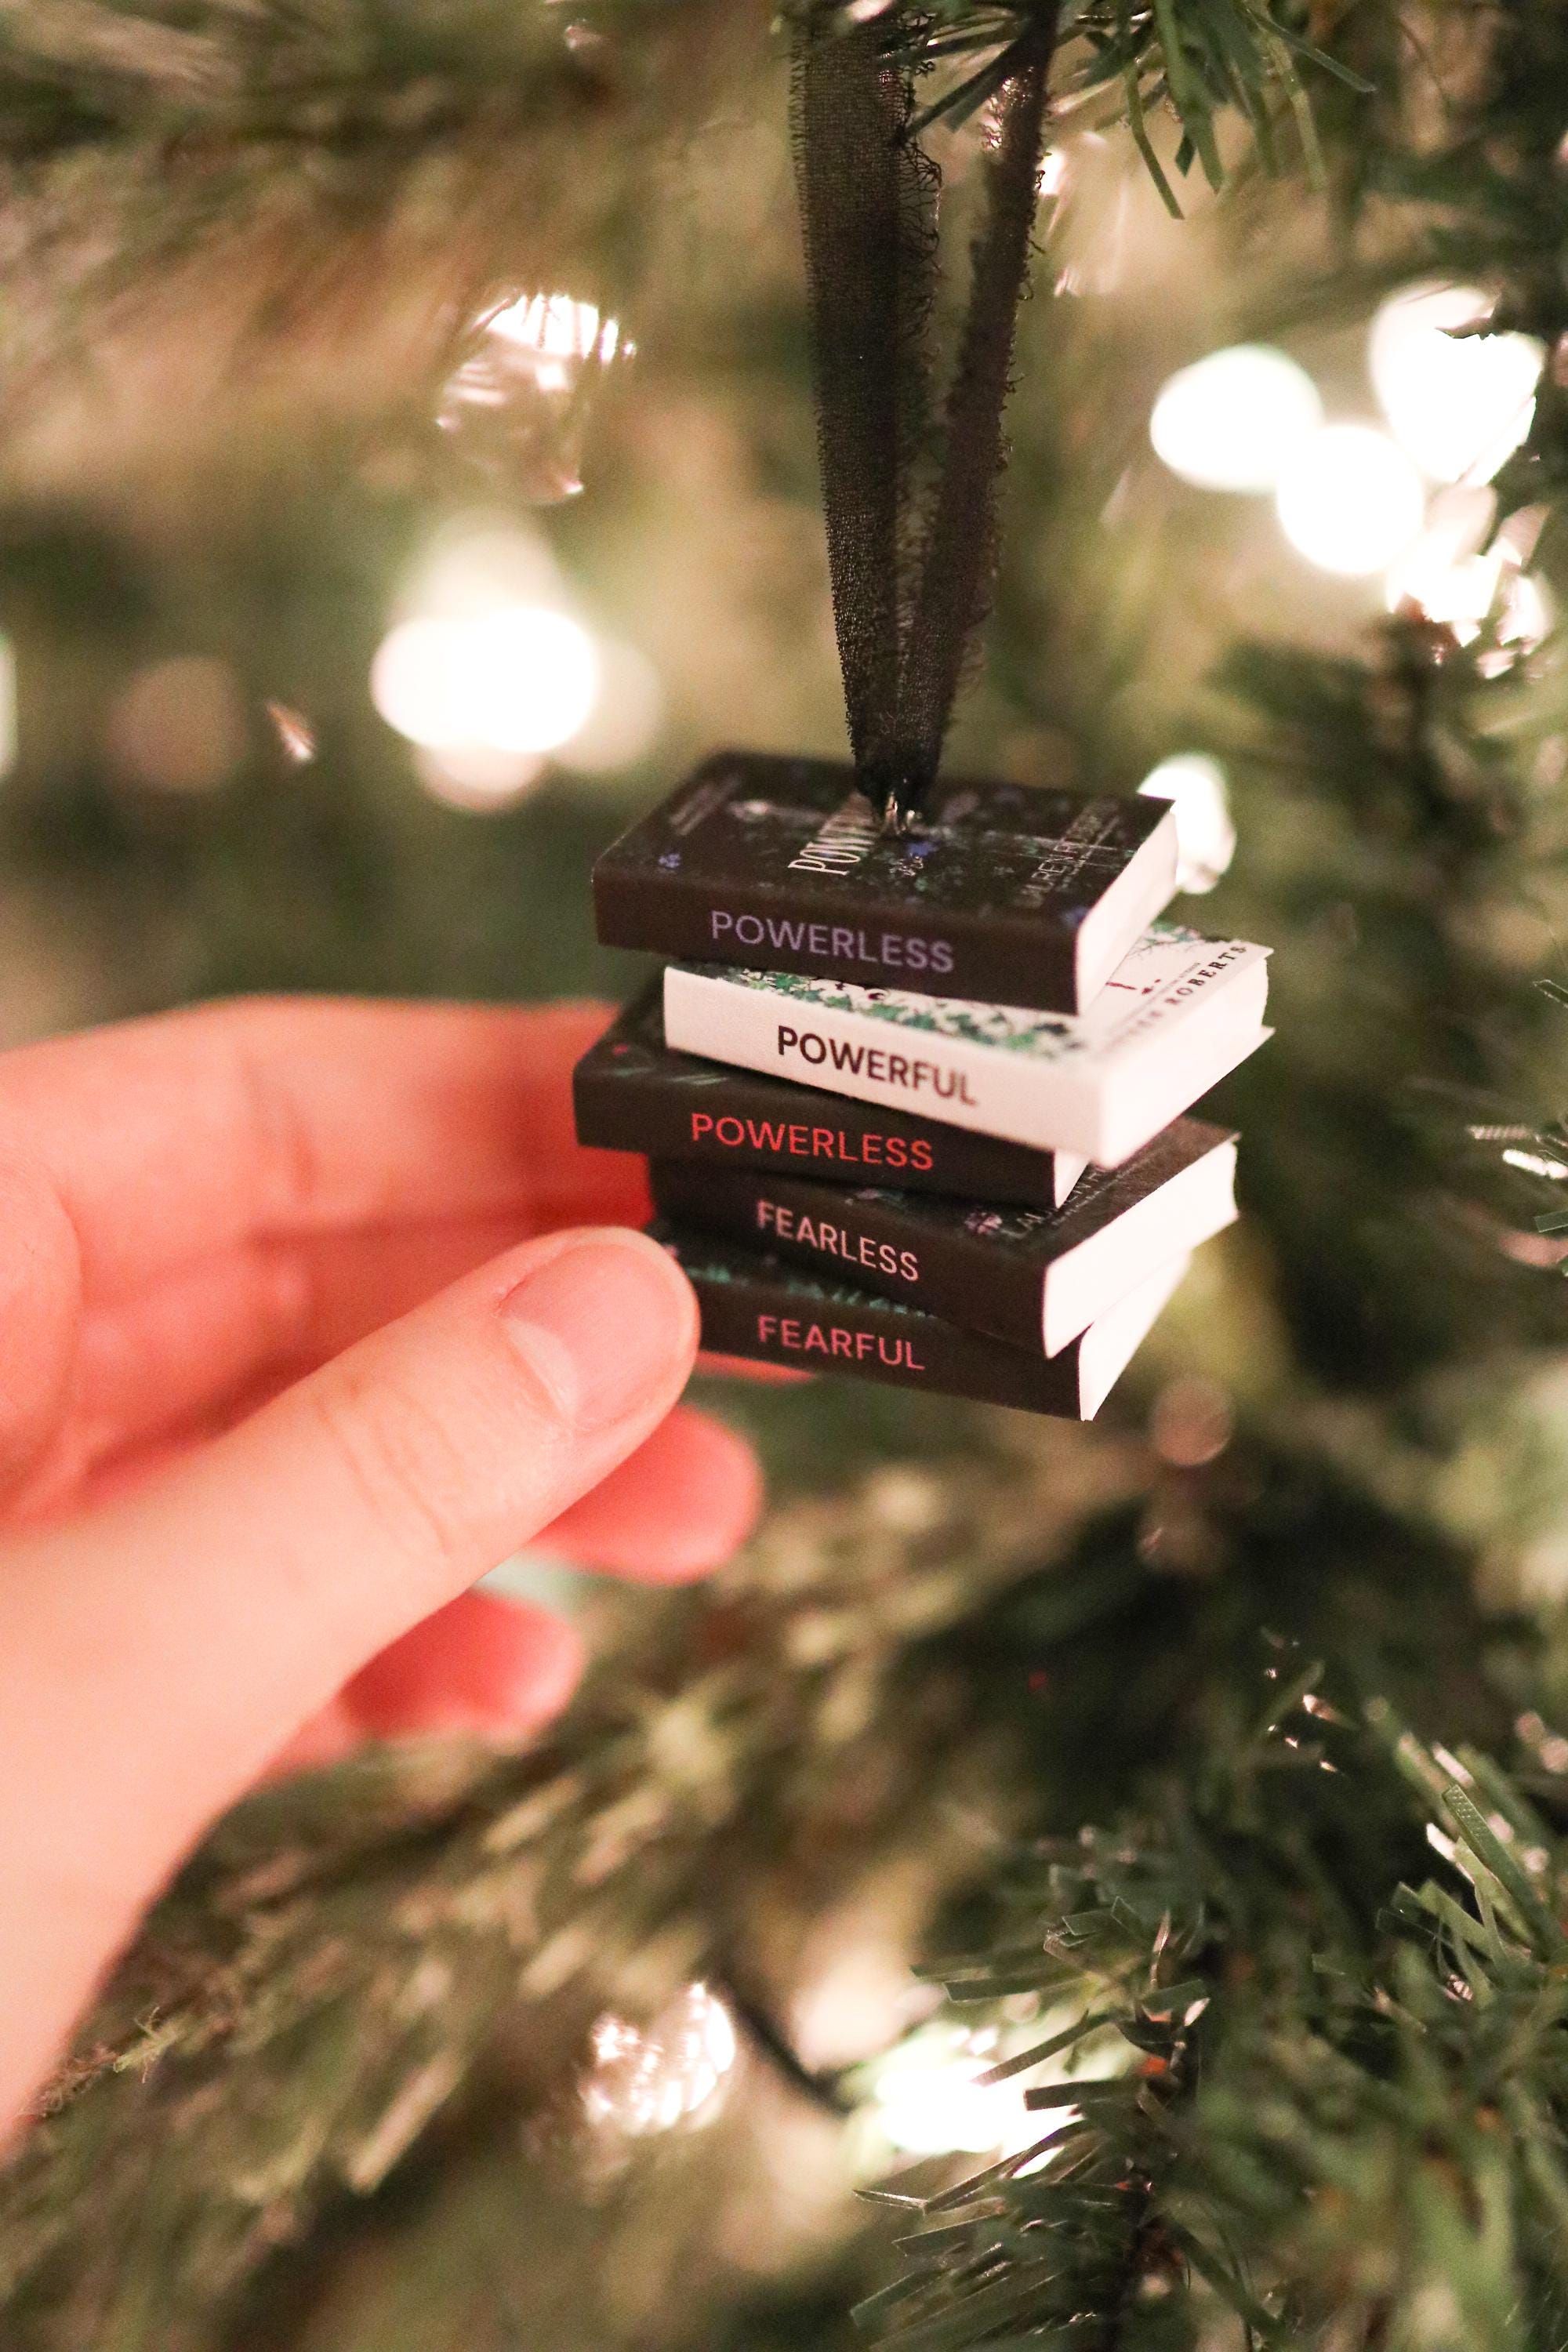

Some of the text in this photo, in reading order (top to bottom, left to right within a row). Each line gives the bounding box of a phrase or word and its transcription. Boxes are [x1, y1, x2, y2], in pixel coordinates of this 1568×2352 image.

[711, 910, 954, 973] POWERLESS
[778, 1025, 977, 1106] POWERFUL
[691, 1113, 933, 1171] POWERLESS
[757, 1200, 919, 1281] FEARLESS
[757, 1314, 925, 1370] FEARFUL
